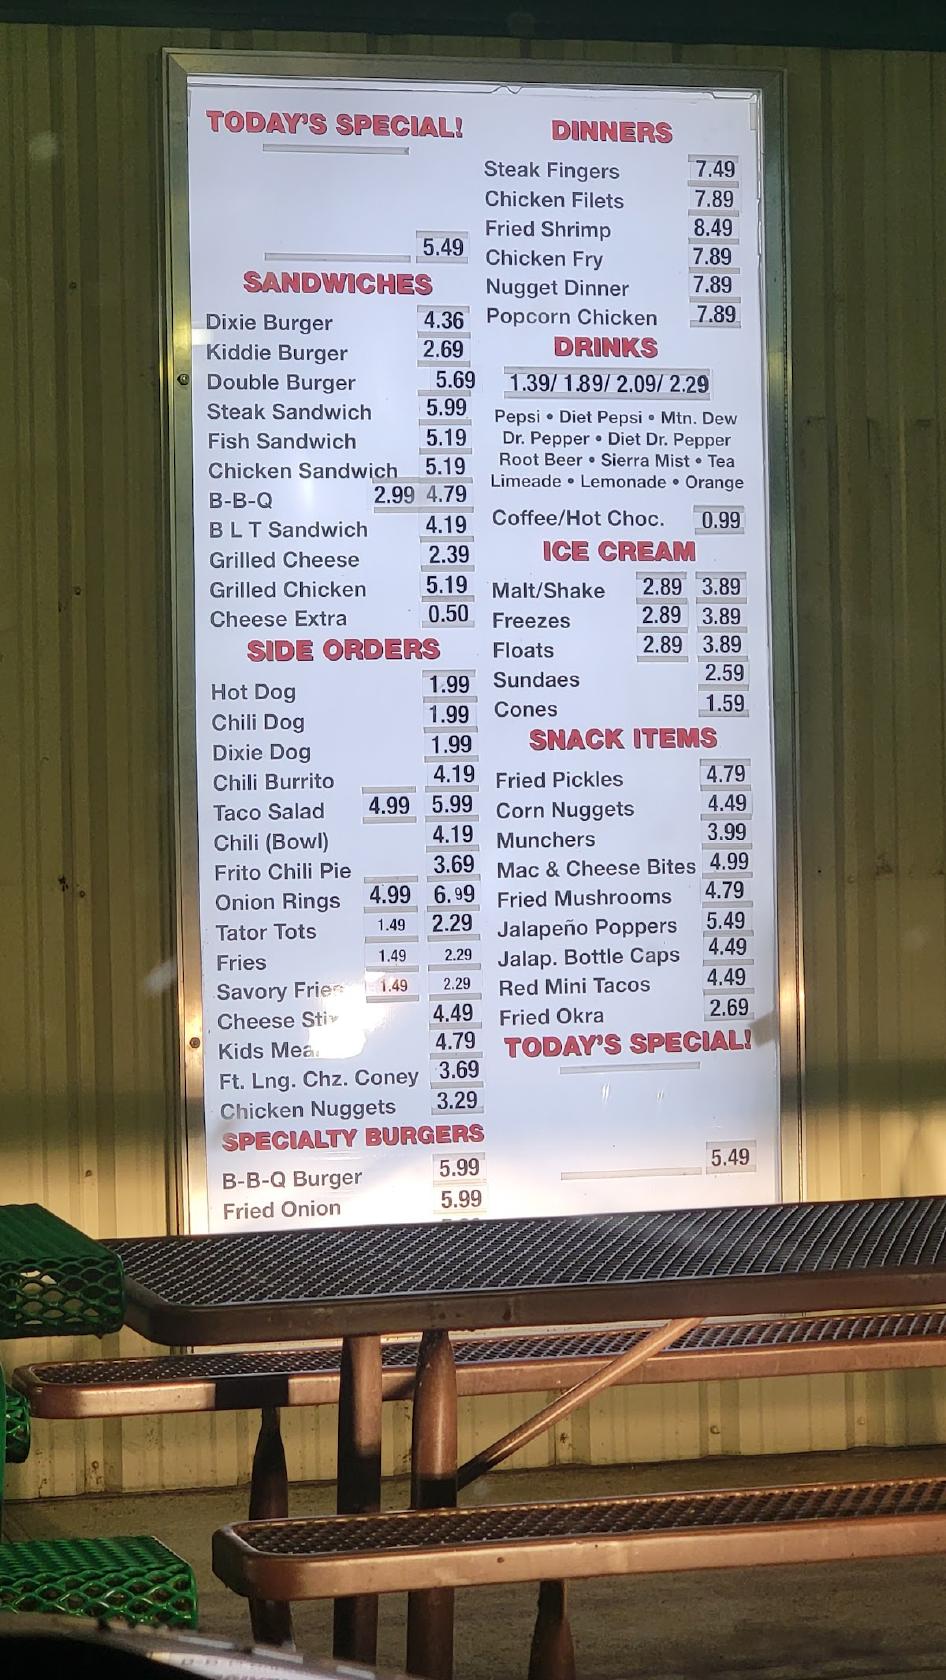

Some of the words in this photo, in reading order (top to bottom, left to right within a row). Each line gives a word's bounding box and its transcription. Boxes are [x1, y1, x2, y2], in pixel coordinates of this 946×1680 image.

[205, 111, 327, 135] TODAY'S
[335, 114, 462, 138] SPECIAL!
[551, 120, 672, 143] DINNERS
[484, 161, 540, 177] Steak
[547, 162, 619, 182] Fingers
[695, 160, 735, 177] 7.49
[485, 220, 534, 236] Fried
[541, 221, 610, 241] Shrimp
[694, 219, 732, 236] 8.49
[423, 238, 463, 256] 5.49
[485, 249, 565, 266] Chicken
[573, 251, 603, 270] Fry
[693, 248, 731, 265] 7.89
[243, 271, 433, 295] SANDWICHES
[206, 314, 256, 330] Dixie
[263, 314, 332, 334] Burger
[424, 311, 463, 329] 4.36
[487, 308, 570, 326] Popcorn
[577, 309, 657, 325] Chicken
[697, 305, 735, 322] 7.89
[206, 344, 271, 360] Kiddie
[278, 345, 348, 364] Burger
[423, 340, 463, 358] 2.69
[554, 337, 658, 358] DRINKS
[510, 374, 557, 392] 1.39/
[564, 374, 610, 392] 1.89/
[616, 374, 663, 392] 2.09/
[669, 375, 708, 393] 2.29
[207, 403, 265, 419] Steak
[272, 404, 371, 420] Sandwich
[426, 398, 466, 416] 5.99
[494, 410, 539, 426] Pepsi
[559, 411, 592, 423] Diet
[597, 411, 641, 426] Pepsi
[661, 411, 696, 424] Mtn.
[702, 412, 737, 424] Dew
[503, 431, 524, 444] Dr.
[530, 431, 590, 448] Pepper
[608, 432, 640, 445] Diet
[646, 433, 667, 445] Dr.
[673, 433, 731, 449] Pepper
[208, 463, 291, 478] Chicken
[298, 463, 397, 478] Sandwich
[425, 457, 465, 474] 5.19
[499, 453, 539, 465] Root
[544, 453, 582, 466] Beer
[601, 453, 649, 467] Sierra
[655, 454, 689, 467] Mist
[707, 455, 734, 467] Tea
[491, 474, 561, 487] Limeade
[581, 475, 666, 488] Lemonade
[685, 475, 743, 491] Orange
[209, 492, 272, 509] B-B-Q
[374, 486, 414, 503] 2.99
[426, 485, 466, 502] 4.79
[209, 522, 222, 538] B
[230, 522, 242, 537] L
[248, 522, 261, 537] T
[268, 521, 367, 538] Sandwich
[425, 516, 466, 533] 4.19
[492, 509, 601, 525] Coffee/Hot
[607, 510, 663, 526] Choc.
[702, 512, 740, 528] 0.99
[209, 552, 275, 568] Grilled
[283, 552, 359, 568] Cheese
[429, 545, 469, 563] 2.39
[543, 541, 589, 561] ICE
[597, 541, 695, 561] CREAM
[492, 582, 605, 598] Malt/Shake
[643, 578, 681, 595] 2.89
[702, 578, 740, 595] 3.89
[210, 611, 287, 627] Cheese
[295, 610, 346, 626] Extra
[428, 604, 468, 622] 0.50
[492, 613, 570, 628] Freezes
[642, 606, 680, 623] 2.89
[702, 608, 740, 624] 3.89
[246, 640, 313, 662] SIDE
[322, 638, 440, 661] ORDERS
[493, 642, 553, 658] Floats
[643, 636, 682, 653] 2.89
[703, 636, 741, 653] 3.89
[493, 672, 579, 688] Sundaes
[705, 664, 744, 681] 2.59
[211, 684, 248, 700] Hot
[254, 684, 295, 703] Dog
[429, 676, 469, 693] 1.99
[494, 702, 557, 717] Cones
[706, 694, 744, 712] 1.59
[213, 744, 262, 761] Dixie
[270, 744, 310, 763] Dog
[431, 735, 471, 753] 1.99
[529, 729, 625, 751] SNACK
[633, 727, 717, 749] ITEMS
[496, 772, 545, 788] Fried
[553, 771, 623, 787] Pickles
[706, 765, 745, 782] 4.79
[212, 805, 260, 821] Taco
[268, 803, 324, 820] Salad
[368, 796, 409, 814] 4.99
[432, 795, 472, 813] 5.99
[213, 834, 258, 851] Chili
[265, 832, 328, 853] (Bowl)
[432, 825, 473, 843] 4.19
[497, 832, 595, 848] Munchers
[707, 823, 746, 840] 3.99
[215, 894, 274, 910] Onion
[282, 893, 340, 912] Rings
[369, 885, 410, 903] 4.99
[434, 885, 474, 903] 6.99
[215, 925, 267, 941] Tator
[273, 924, 316, 939] Tots
[378, 919, 405, 931] 1.49
[432, 914, 472, 932] 2.29
[497, 920, 587, 940] Jalapeño
[595, 919, 676, 937] Poppers
[706, 912, 744, 929] 5.49
[217, 955, 266, 971] Fries
[380, 950, 406, 962] 1.49
[444, 949, 471, 960] 2.29
[497, 951, 556, 969] Jalap.
[564, 949, 623, 965] Bottle
[630, 948, 679, 966] Caps
[708, 938, 746, 955] 4.49
[499, 979, 538, 996] Red
[545, 978, 586, 994] Mini
[592, 978, 650, 993] Tacos
[707, 968, 745, 985] 4.49
[499, 1009, 549, 1025] Fried
[556, 1008, 603, 1023] Okra
[710, 998, 748, 1016] 2.69
[503, 1034, 621, 1058] TODAY'S
[629, 1029, 751, 1054] SPECIAL!
[219, 1074, 244, 1089] Ft.
[252, 1073, 295, 1092] Lng.
[303, 1071, 347, 1087] Chz.
[354, 1070, 418, 1087] Coney
[439, 1060, 479, 1079] 3.69
[220, 1103, 303, 1119] Chicken
[311, 1100, 395, 1119] Nuggets
[437, 1091, 477, 1109] 3.29
[221, 1129, 357, 1151] SPECIALTY
[365, 1124, 484, 1146] BURGERS
[711, 1148, 749, 1166] 5.49
[222, 1171, 285, 1189] B-B-Q
[293, 1171, 362, 1189] Burger
[439, 1158, 479, 1177] 5.99
[223, 1202, 274, 1219] Fried
[281, 1200, 340, 1217] Onion
[441, 1190, 481, 1208] 5.99
